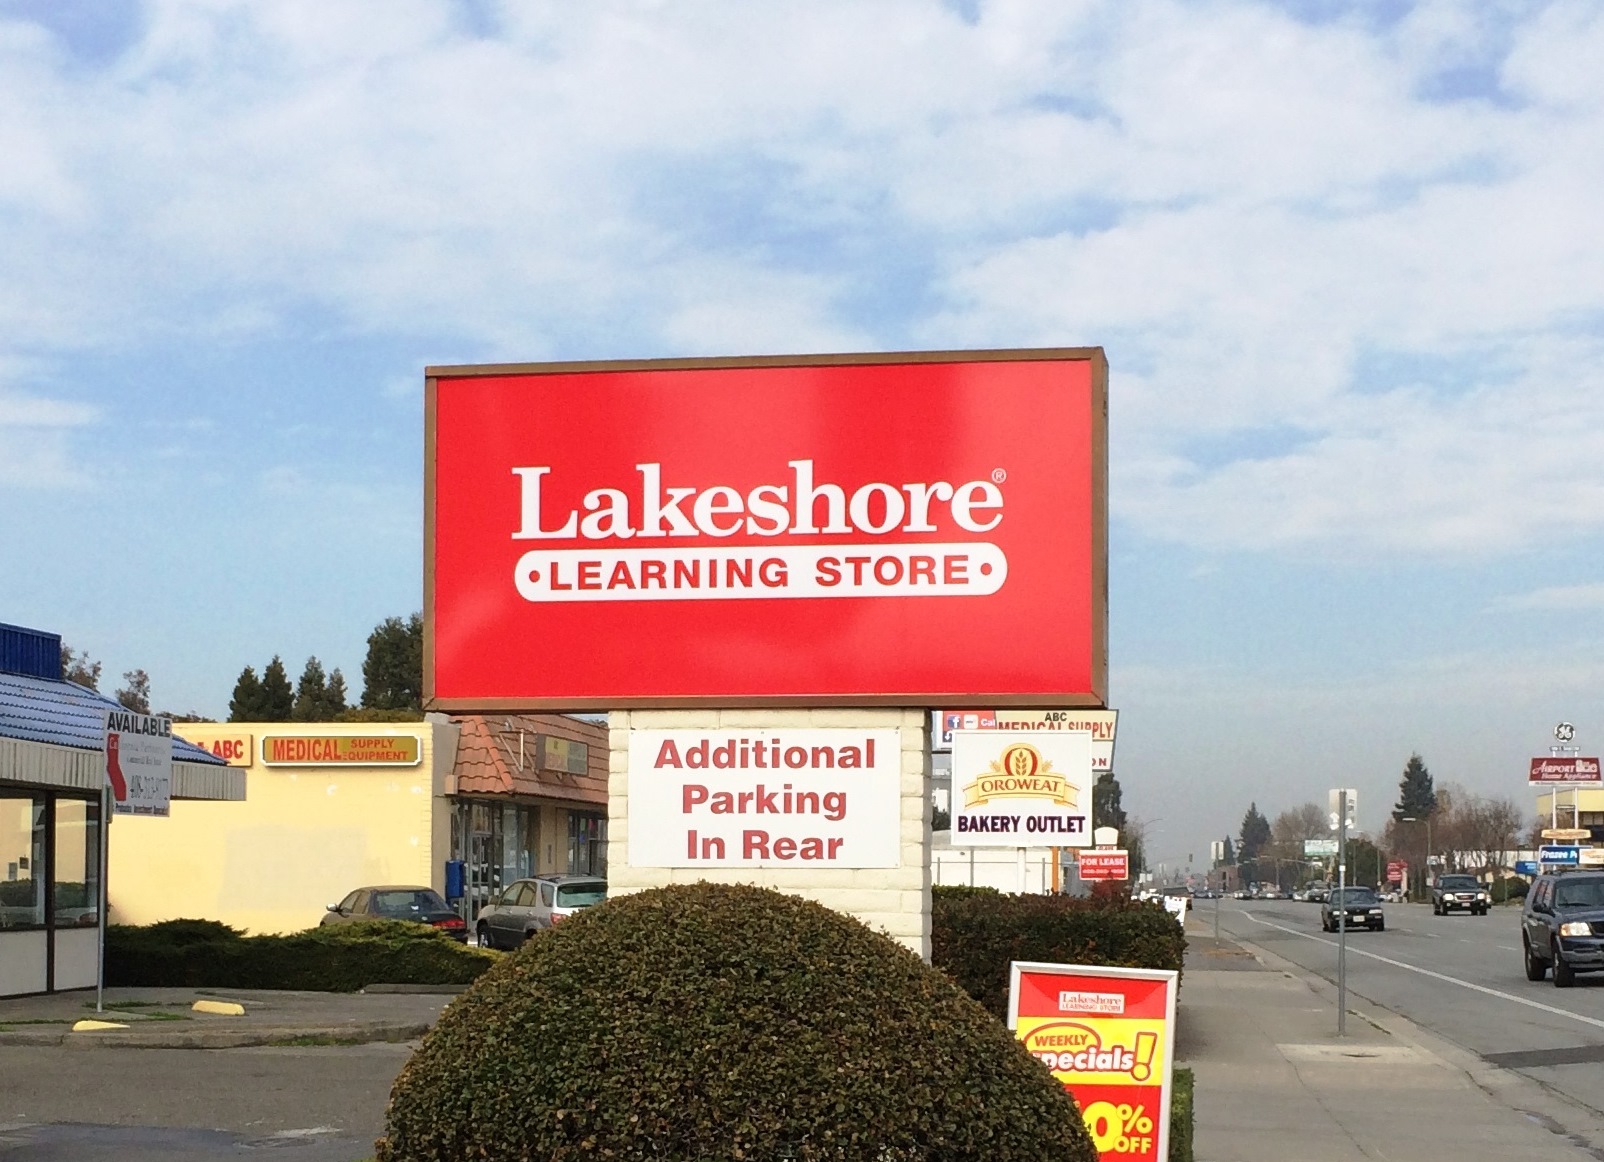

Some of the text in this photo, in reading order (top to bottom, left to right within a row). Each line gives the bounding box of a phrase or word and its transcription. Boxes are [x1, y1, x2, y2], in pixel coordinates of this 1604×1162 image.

[510, 459, 1004, 540] Lakeshore
[549, 554, 970, 591] LEARNING STORE
[107, 711, 171, 738] AVAILABLE
[1044, 711, 1068, 722] ABC
[212, 739, 244, 759] ABC
[272, 738, 395, 761] MEDICAL SUPPLY
[343, 750, 409, 761] EQUIPMENT
[653, 738, 876, 769] Additional
[980, 778, 1062, 794] OROWEAT
[682, 783, 848, 822] Parking
[957, 815, 1086, 833] BAKERY OUTLET
[687, 829, 844, 861] In Rear
[1081, 858, 1126, 866] FOR LEASE
[1062, 993, 1122, 1005] Lakeshore
[1034, 1034, 1089, 1047] WEEKLY
[1113, 1135, 1153, 1154] OFF
